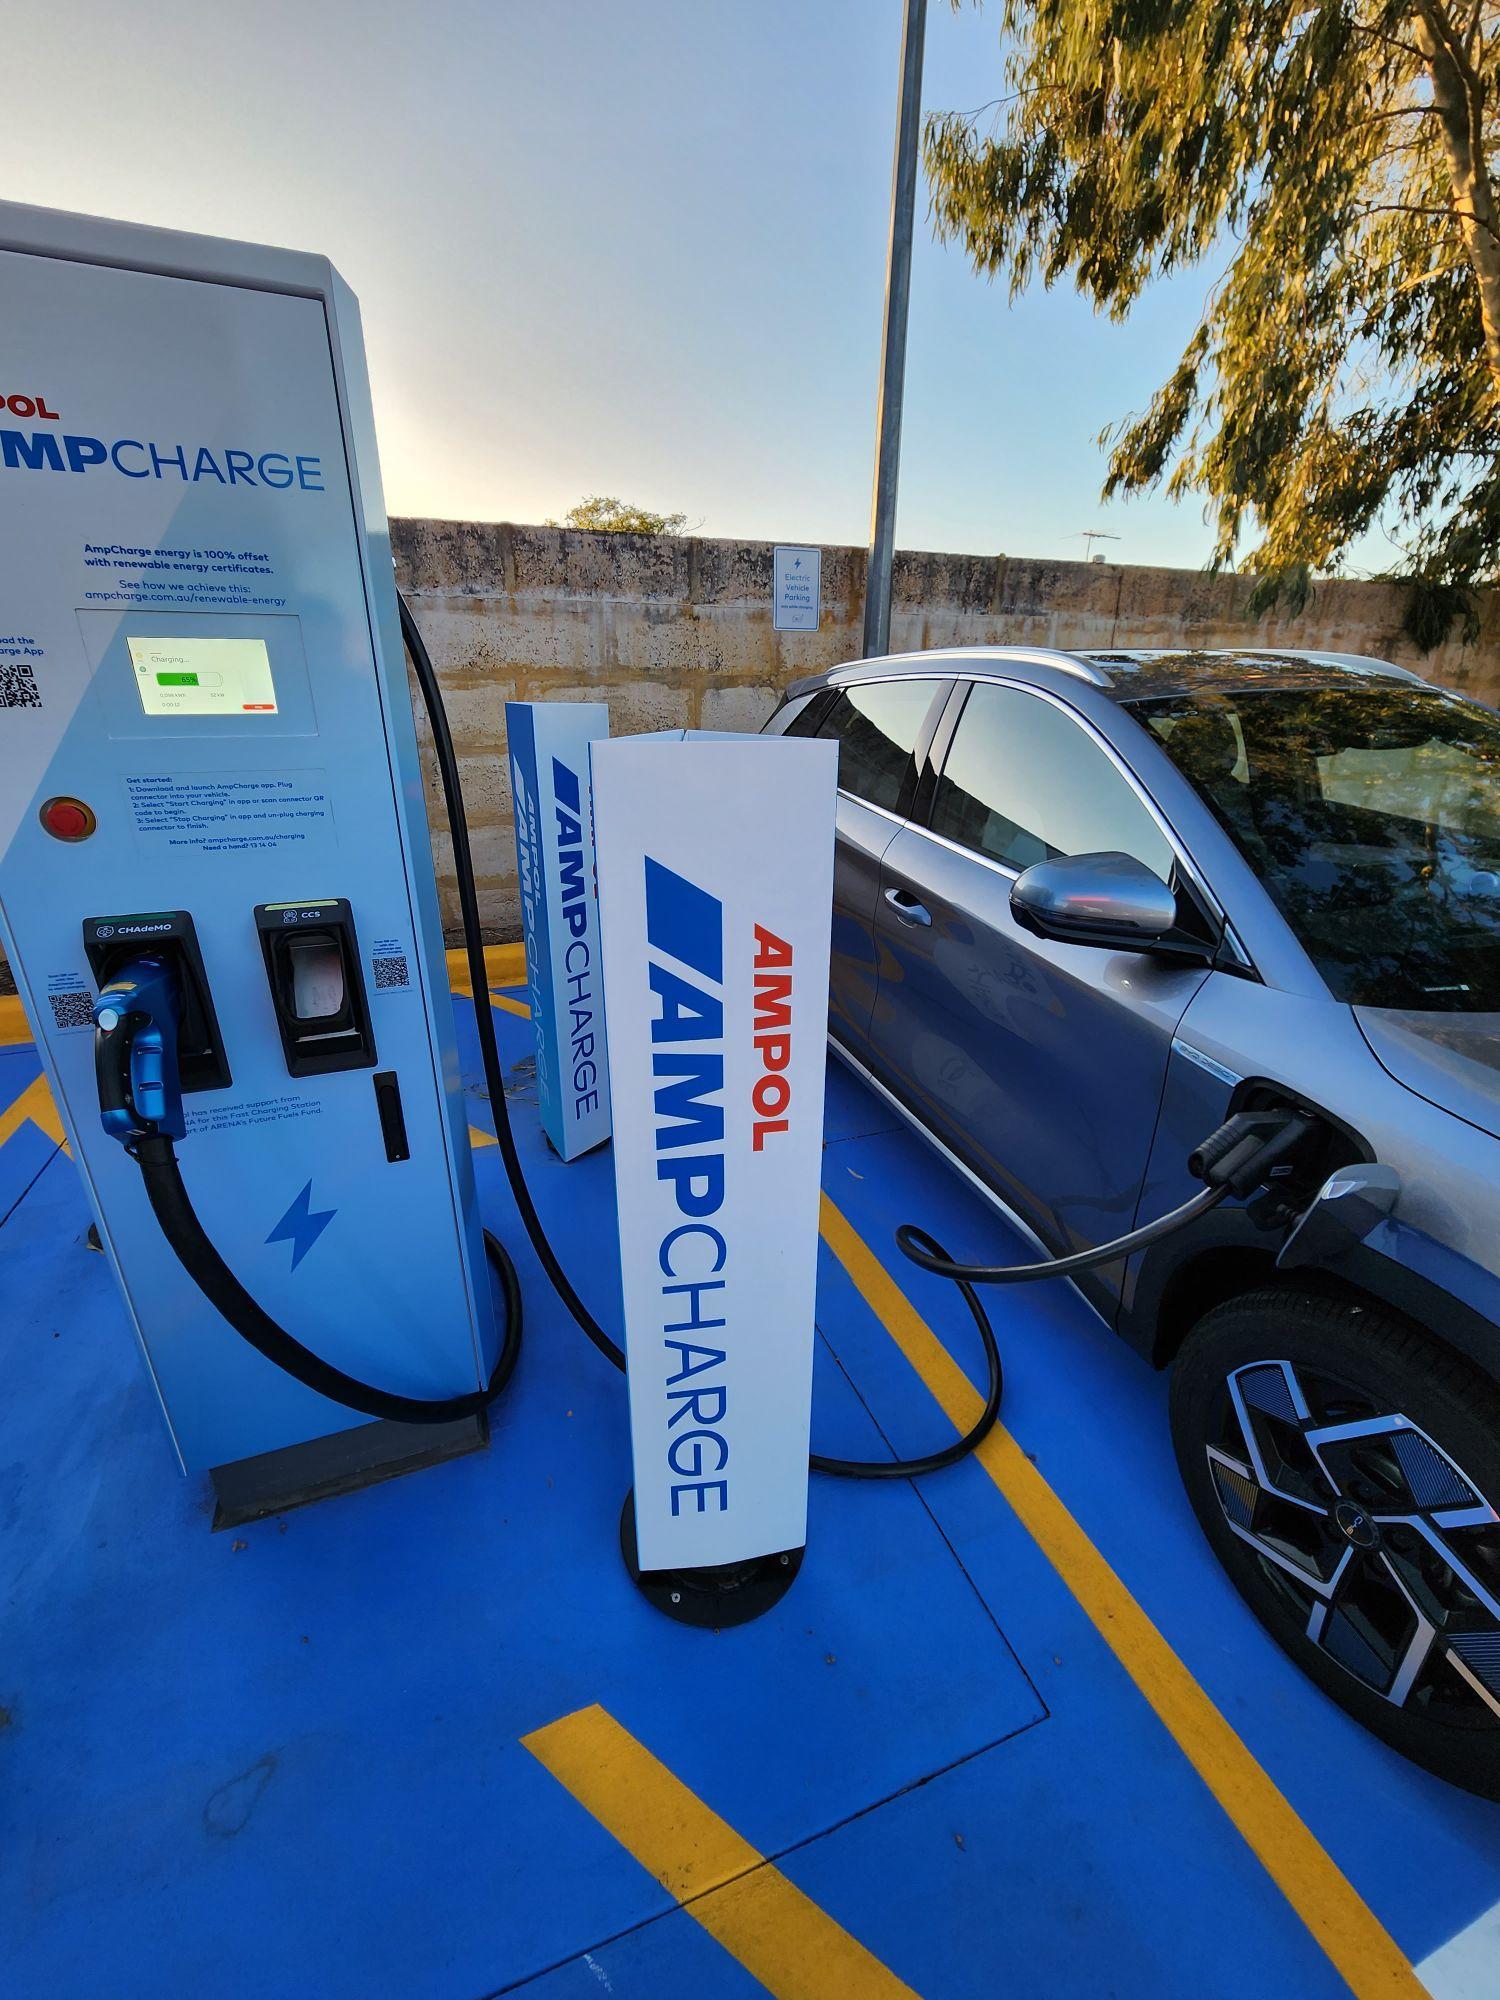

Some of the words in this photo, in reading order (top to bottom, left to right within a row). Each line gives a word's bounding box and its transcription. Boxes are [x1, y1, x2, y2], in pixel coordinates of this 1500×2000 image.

[84, 544, 152, 557] AmpCharge
[154, 549, 191, 560] energy
[192, 549, 202, 558] is
[204, 550, 236, 560] 100%
[237, 552, 270, 562] offset
[84, 557, 111, 567] with
[113, 559, 171, 570] renewable
[173, 563, 209, 573] energy
[211, 564, 275, 574] certificates.
[784, 573, 811, 582] Electric
[119, 579, 141, 589] See
[142, 581, 166, 590] how
[168, 583, 185, 591] we
[187, 583, 227, 593] achieve
[228, 584, 252, 594] this:
[785, 584, 810, 592] Vehicle
[84, 591, 287, 607] ampcharge.com.au/renewable-energy
[784, 593, 811, 603] Parking
[17, 636, 35, 645] the
[23, 647, 44, 657] App
[142, 776, 173, 784] started:
[135, 785, 174, 793] Download
[216, 783, 260, 791] AmpCharge
[277, 781, 293, 789] Plug
[203, 791, 231, 799] vehicle.
[190, 798, 227, 807] Charging"
[144, 816, 169, 824] Select
[192, 814, 228, 822] Charging"
[295, 810, 325, 818] charging
[163, 808, 187, 816] begin.
[207, 834, 306, 843] ampcharge.com.au/charging
[527, 791, 541, 906] AMPOL
[301, 911, 321, 919] CCS
[117, 923, 172, 935] CHAdeMO
[555, 806, 600, 1121] AMPCHARGE
[751, 922, 794, 1153] AMPOL
[209, 1104, 244, 1114] received
[246, 1099, 279, 1109] support
[230, 1111, 250, 1119] Fast
[251, 1105, 289, 1117] Charging
[291, 1101, 321, 1109] Station
[210, 1121, 247, 1130] ARENA's
[248, 1116, 277, 1124] Future
[277, 1112, 300, 1120] Fuels
[300, 1108, 324, 1117] Fund.
[648, 959, 730, 1518] AMPCHARGE
